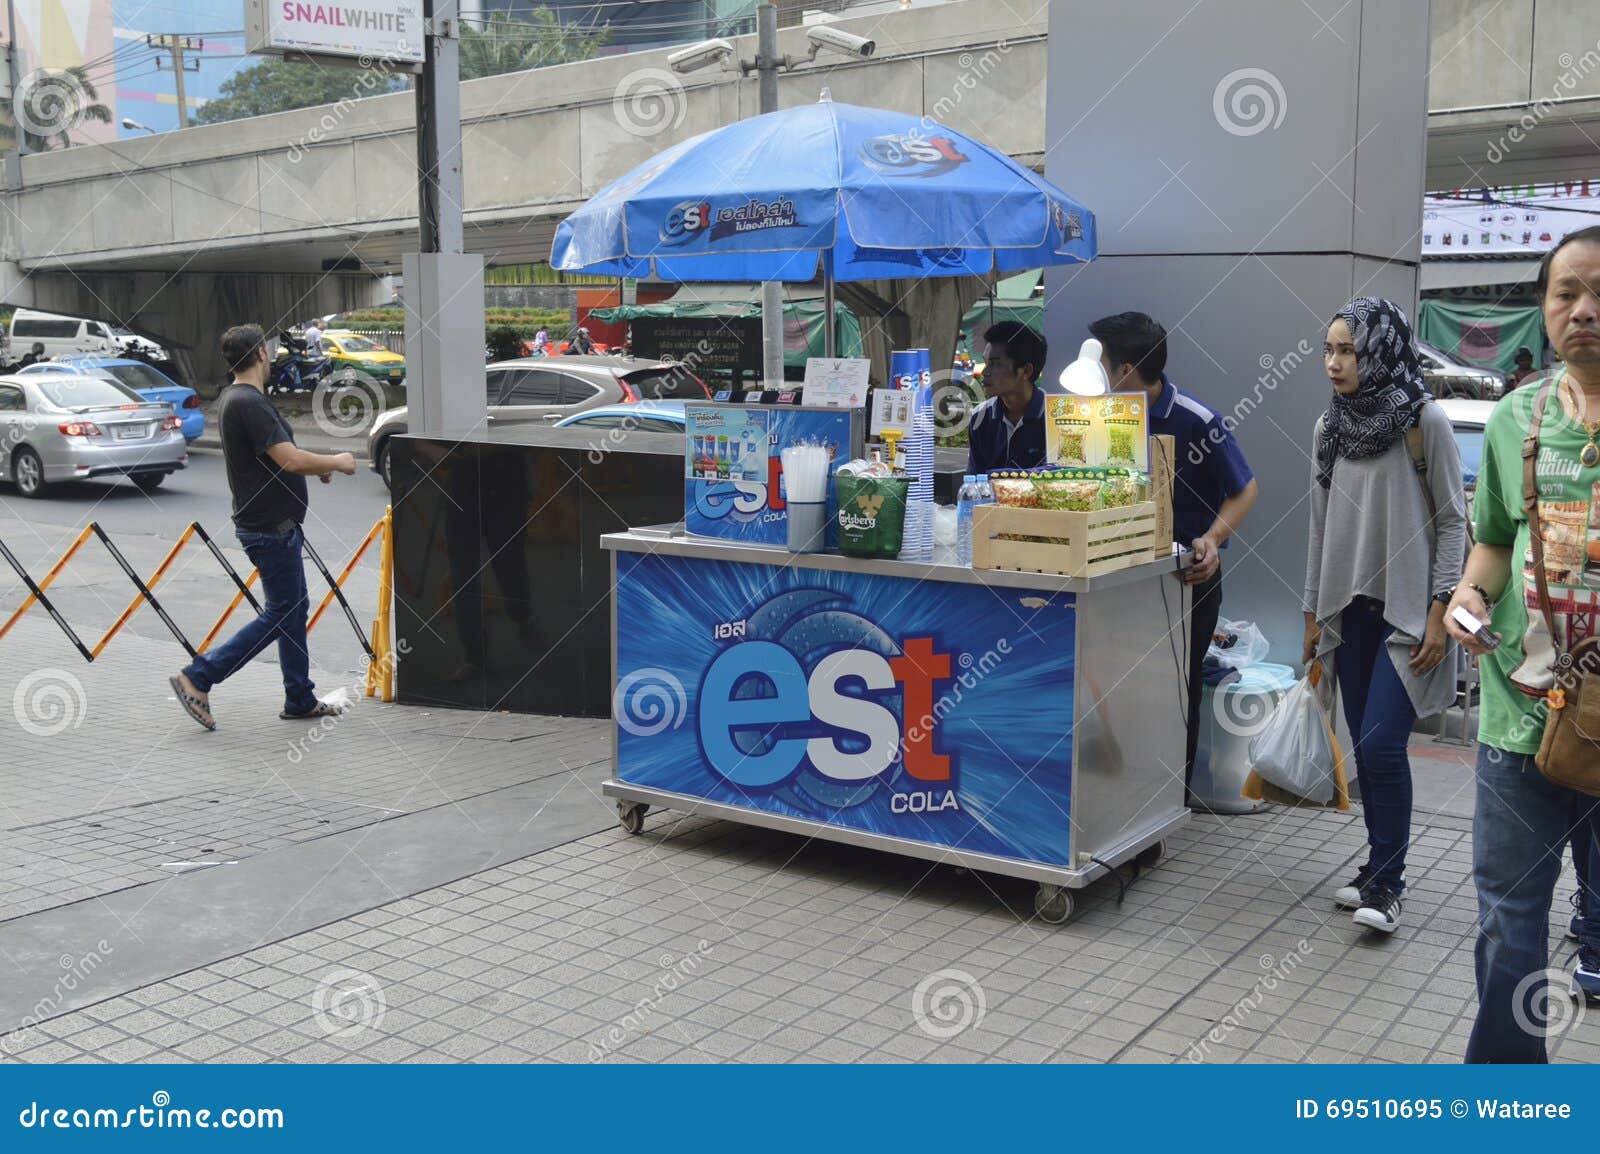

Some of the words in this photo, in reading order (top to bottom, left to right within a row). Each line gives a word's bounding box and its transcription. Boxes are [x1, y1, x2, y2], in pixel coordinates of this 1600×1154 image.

[283, 2, 406, 33] SNAILWHITE
[862, 137, 970, 166] est
[664, 202, 711, 236] est
[1540, 447, 1560, 462] The
[1536, 458, 1583, 481] uality
[763, 512, 788, 523] COLA
[838, 509, 876, 531] Carlsberg
[715, 619, 746, 639] เอส
[700, 637, 950, 786] est
[890, 790, 959, 814] COLA
